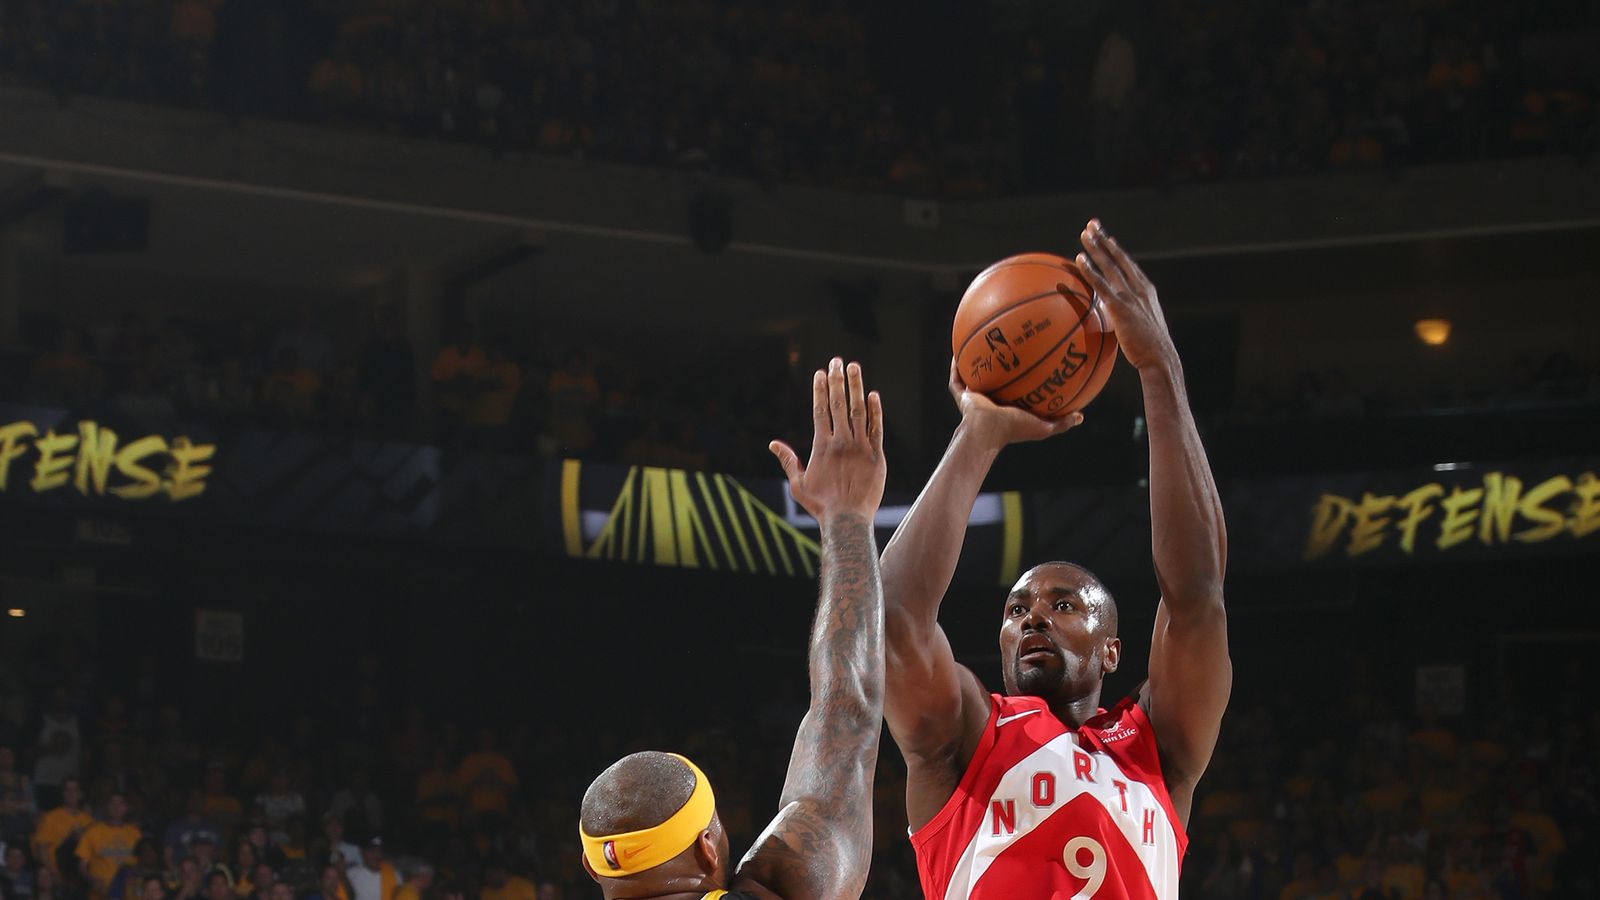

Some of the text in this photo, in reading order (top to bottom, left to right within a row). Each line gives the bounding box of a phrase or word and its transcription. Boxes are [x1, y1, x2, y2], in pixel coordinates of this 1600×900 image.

[1014, 341, 1088, 411] SPALDI
[1304, 472, 1600, 561] DEFENSE
[1118, 728, 1136, 739] Life
[991, 751, 1155, 846] NORTH
[1063, 836, 1107, 900] 9
